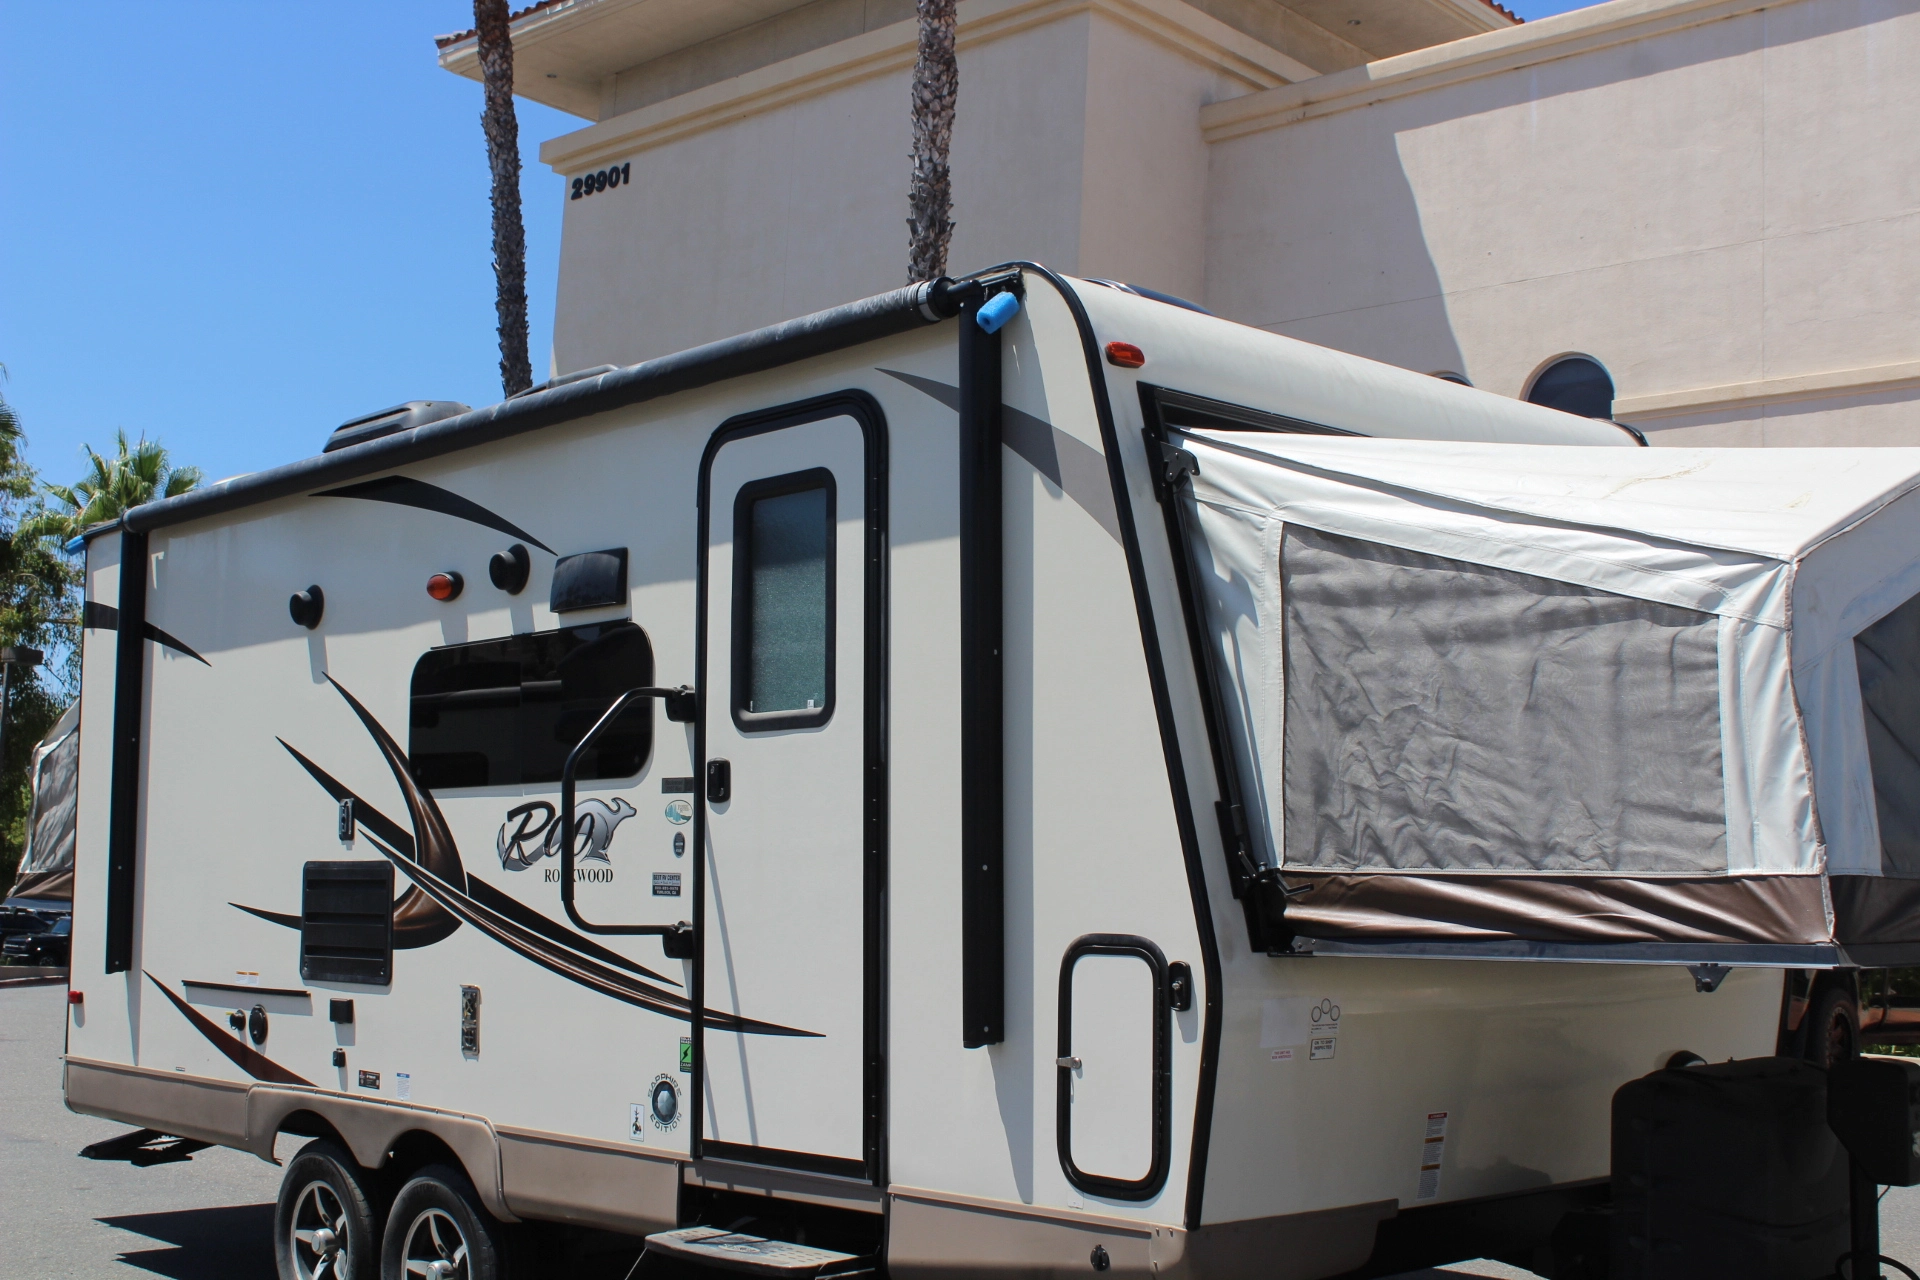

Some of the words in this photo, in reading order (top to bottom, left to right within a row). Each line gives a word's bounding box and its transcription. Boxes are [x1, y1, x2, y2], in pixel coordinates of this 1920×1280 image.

[570, 162, 631, 200] 29901
[544, 868, 614, 883] ROWOOD
[648, 1073, 681, 1098] SAPPHIRE
[650, 1112, 682, 1133] EDITION
